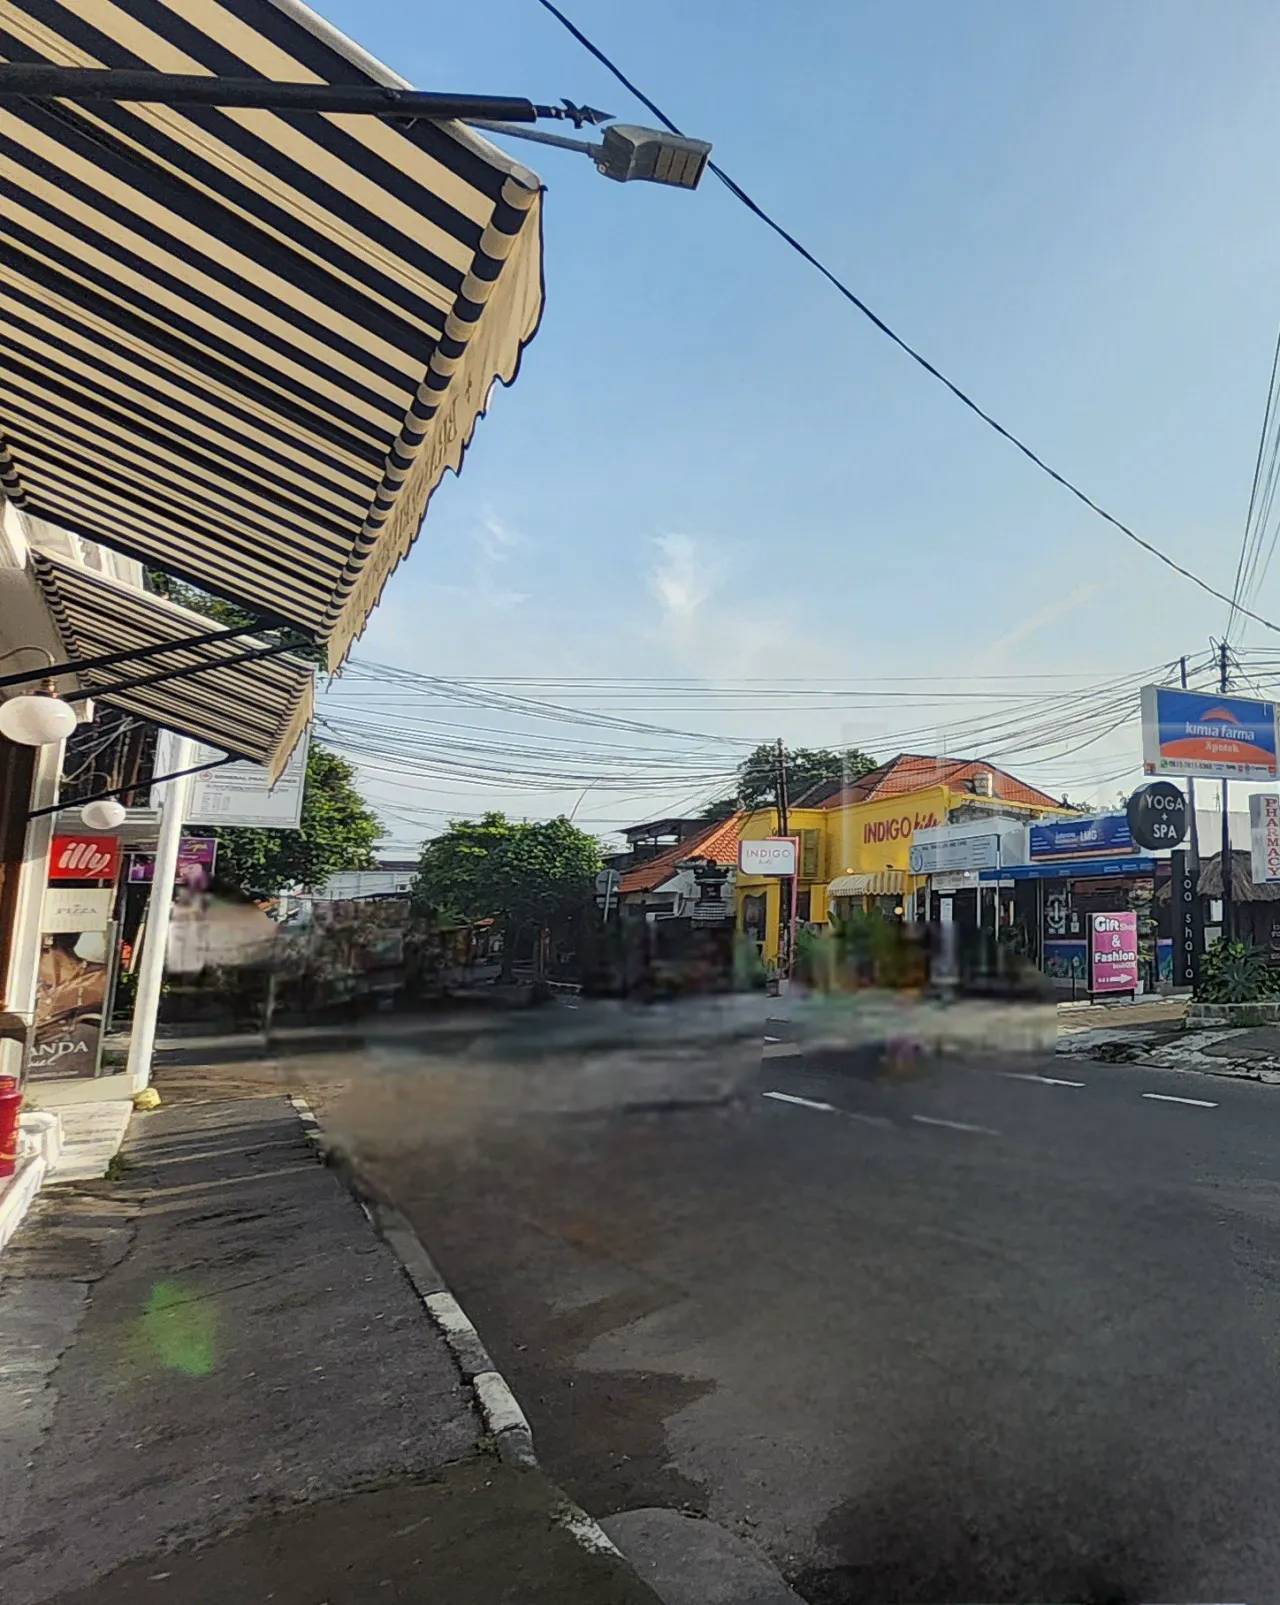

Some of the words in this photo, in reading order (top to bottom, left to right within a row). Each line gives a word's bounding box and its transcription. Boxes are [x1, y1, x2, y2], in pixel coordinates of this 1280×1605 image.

[1185, 720, 1219, 737] kimia
[1221, 724, 1255, 740] farma
[1146, 794, 1184, 811] YOGA
[864, 816, 912, 844] INDIGO
[1153, 823, 1178, 839] SPA
[1263, 797, 1280, 876] PHARMACY
[58, 842, 111, 877] illy
[746, 849, 791, 858] INDIGO
[56, 907, 99, 915] PIZZA
[1094, 916, 1120, 932] Gift
[1111, 934, 1121, 947] &
[1094, 949, 1135, 963] Fashion
[29, 1041, 89, 1057] ANDA
